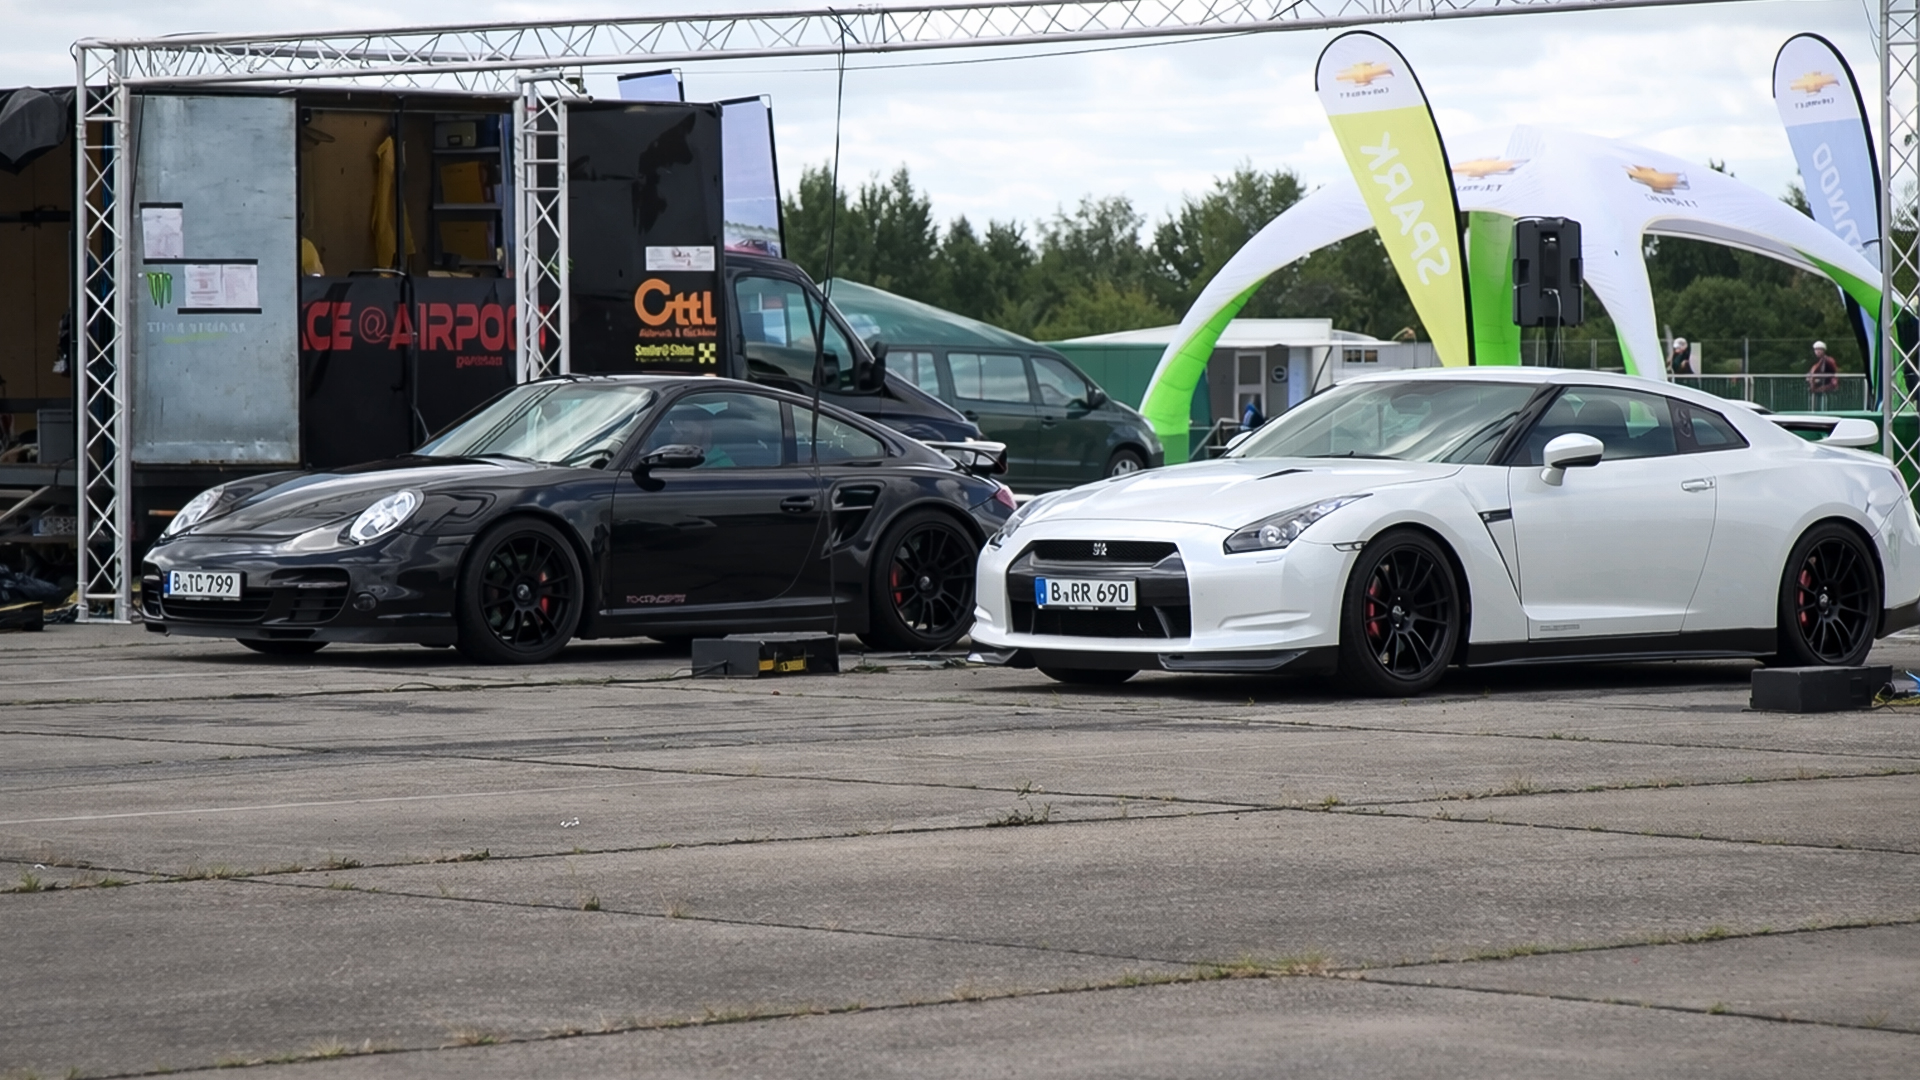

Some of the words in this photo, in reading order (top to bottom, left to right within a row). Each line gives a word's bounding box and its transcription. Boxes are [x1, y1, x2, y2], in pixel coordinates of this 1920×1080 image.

[302, 301, 353, 351] CE
[206, 574, 234, 593] 799
[1071, 583, 1092, 602] RR
[1097, 583, 1129, 603] 690
